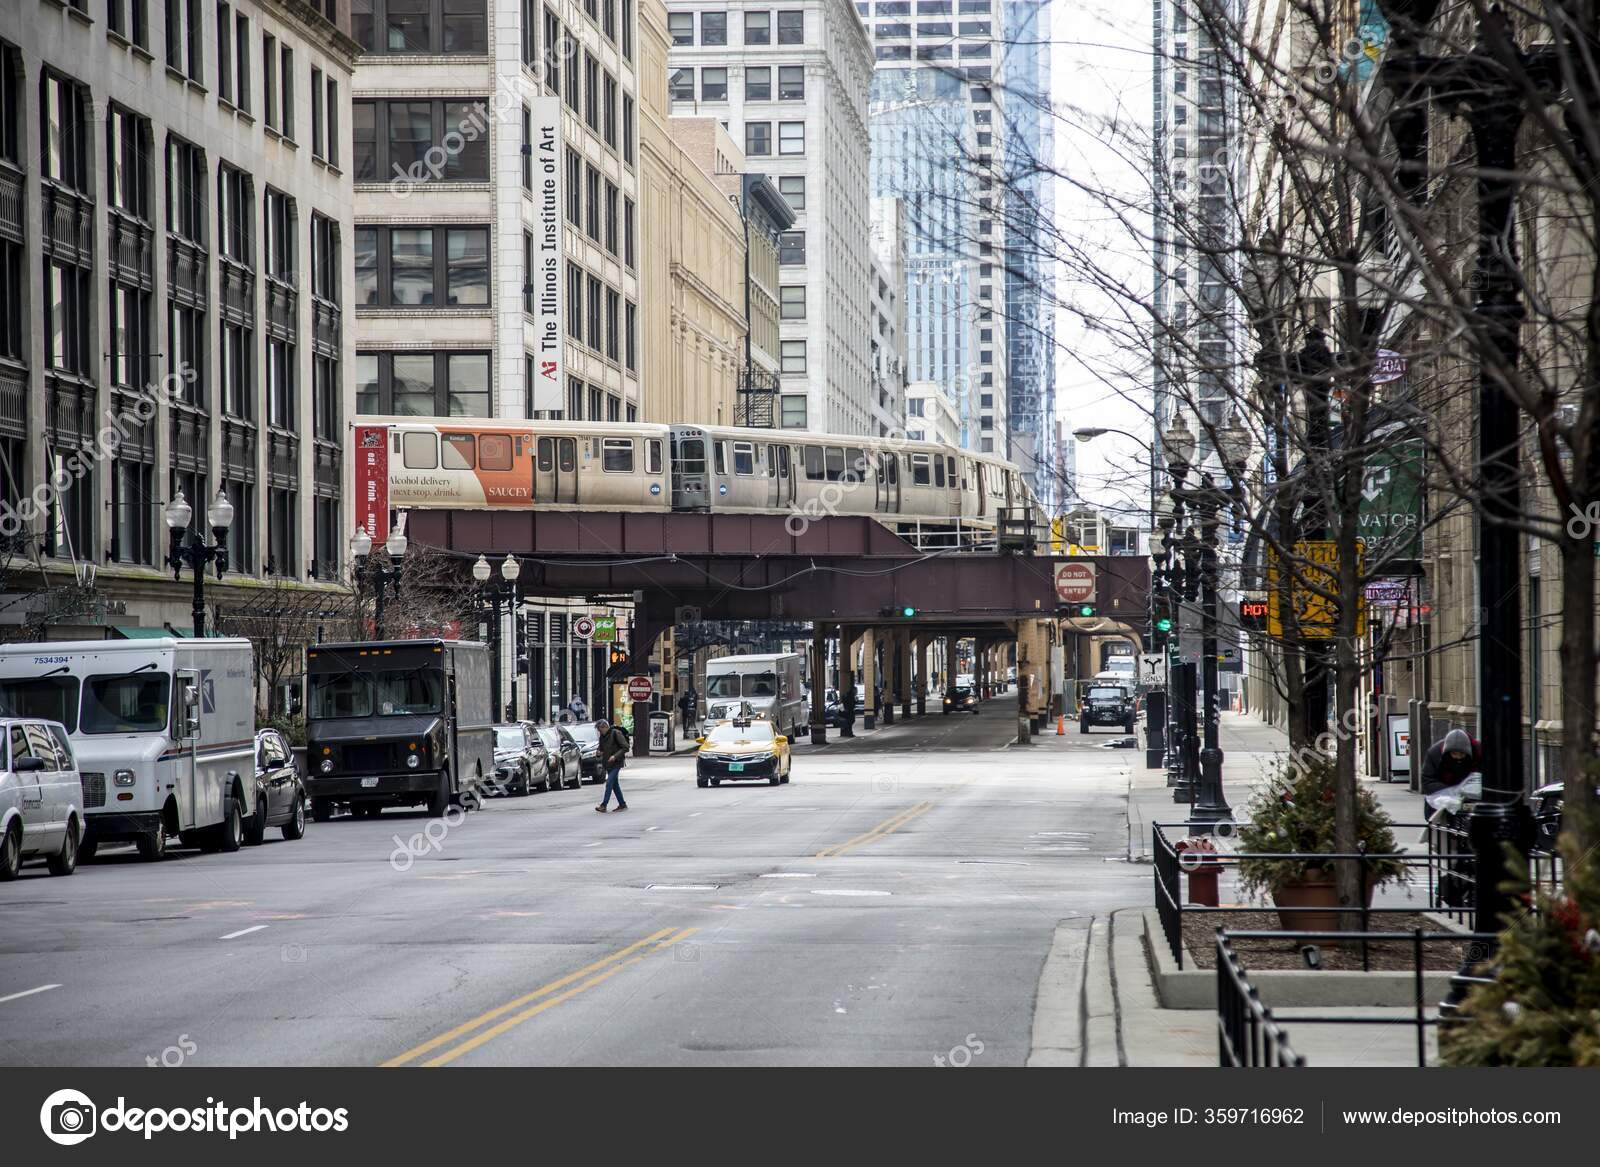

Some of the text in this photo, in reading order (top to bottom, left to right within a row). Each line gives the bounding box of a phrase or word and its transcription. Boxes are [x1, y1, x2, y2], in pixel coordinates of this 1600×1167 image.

[539, 126, 555, 153] Art
[539, 157, 556, 174] of
[540, 179, 557, 251] Institute
[541, 257, 557, 316] Illinois
[541, 321, 557, 352] The
[367, 452, 376, 466] eat
[420, 475, 451, 488] delivery
[367, 480, 377, 502] drink
[393, 488, 410, 497] next
[488, 487, 530, 497] SAUCEY
[34, 656, 69, 665] 7534394
[1145, 675, 1163, 683] ONLY
